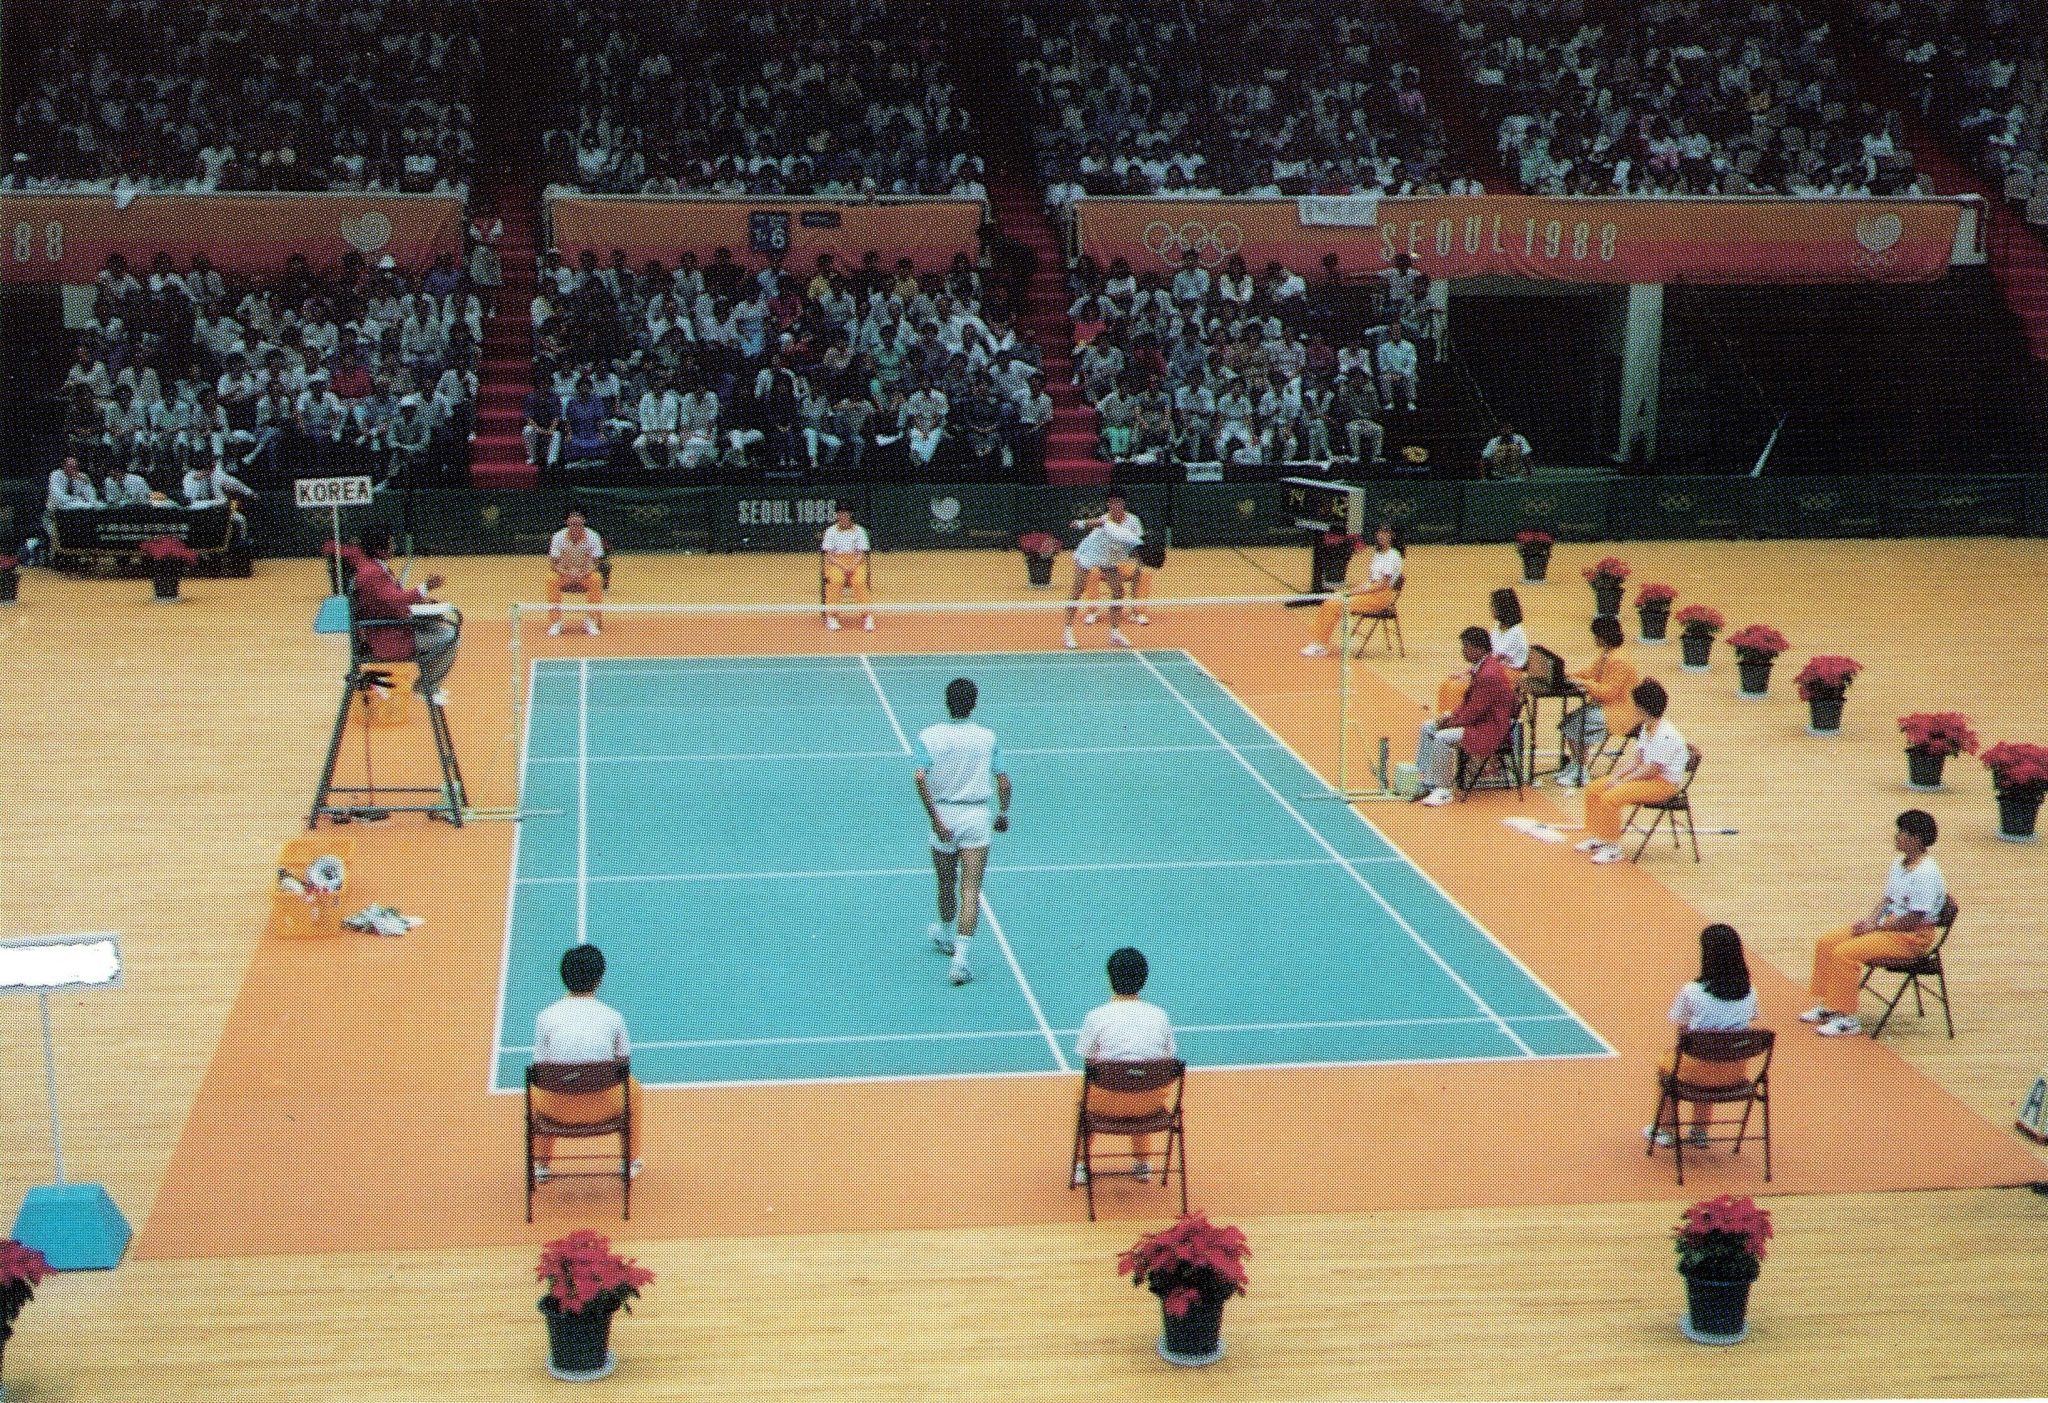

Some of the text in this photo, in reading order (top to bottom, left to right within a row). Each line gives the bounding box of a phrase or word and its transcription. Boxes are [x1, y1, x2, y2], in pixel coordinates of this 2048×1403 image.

[15, 221, 63, 262] 88
[1380, 214, 1618, 262] SEOUL 1988
[298, 480, 369, 503] KOREA
[738, 498, 837, 525] SEOUL 1988
